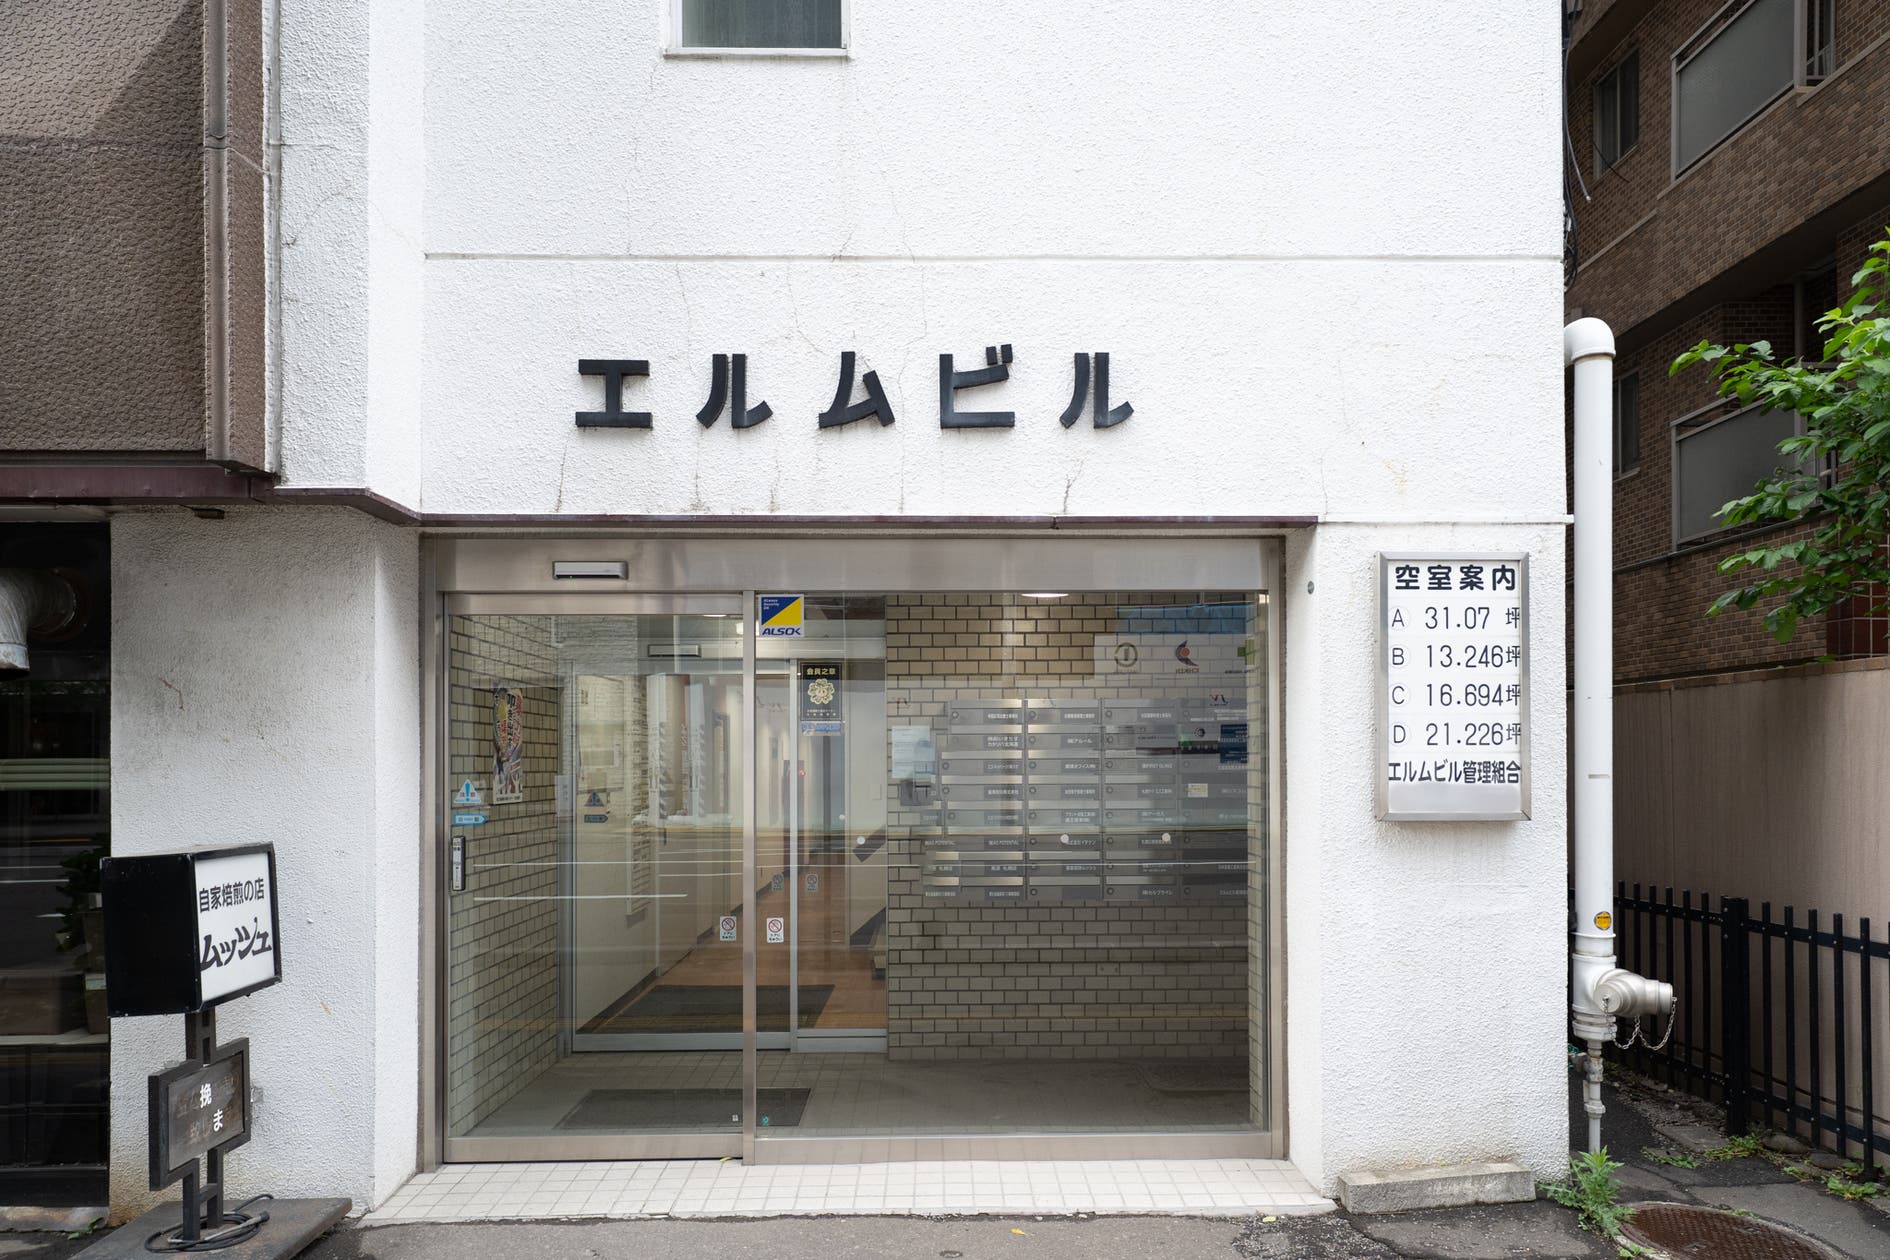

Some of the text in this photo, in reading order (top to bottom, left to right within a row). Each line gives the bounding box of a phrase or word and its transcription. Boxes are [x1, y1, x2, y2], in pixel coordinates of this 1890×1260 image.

[575, 343, 1134, 429] エルムビル
[1395, 565, 1516, 591] 空室案内
[1391, 607, 1521, 629] A 31.07 坪
[762, 627, 801, 636] ALSOK
[1392, 647, 1405, 666] B
[1391, 686, 1405, 705] C
[1393, 725, 1406, 744] D
[1388, 760, 1521, 784] エルムビル管理組合
[198, 877, 265, 914] 自家焙煎の店
[199, 916, 273, 972] ムッシュ
